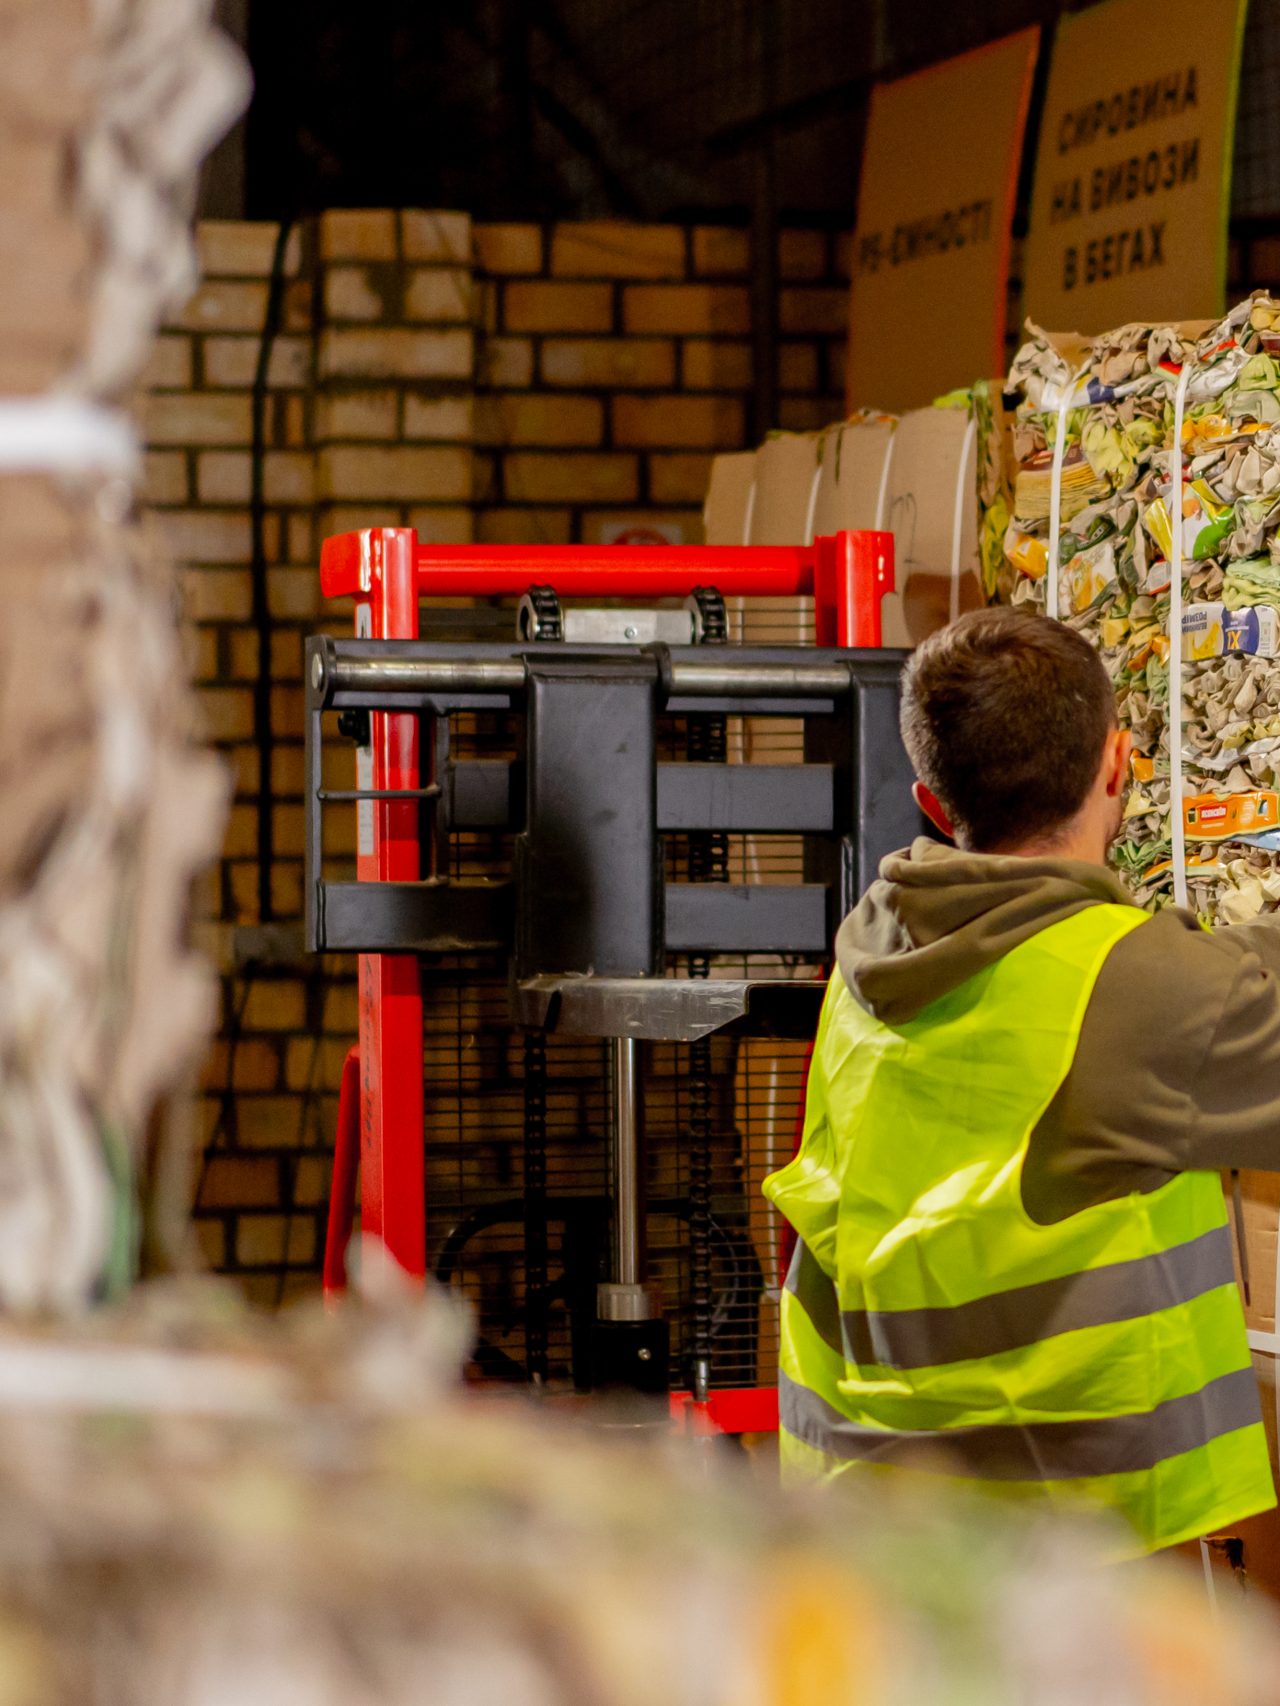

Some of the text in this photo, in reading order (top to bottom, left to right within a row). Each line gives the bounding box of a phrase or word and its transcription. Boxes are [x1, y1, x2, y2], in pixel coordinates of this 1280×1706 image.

[1058, 66, 1198, 155] СИРОВИНА
[1050, 138, 1199, 226] НА ВИВОЗИ
[1063, 221, 1166, 292] В БЕГАХ
